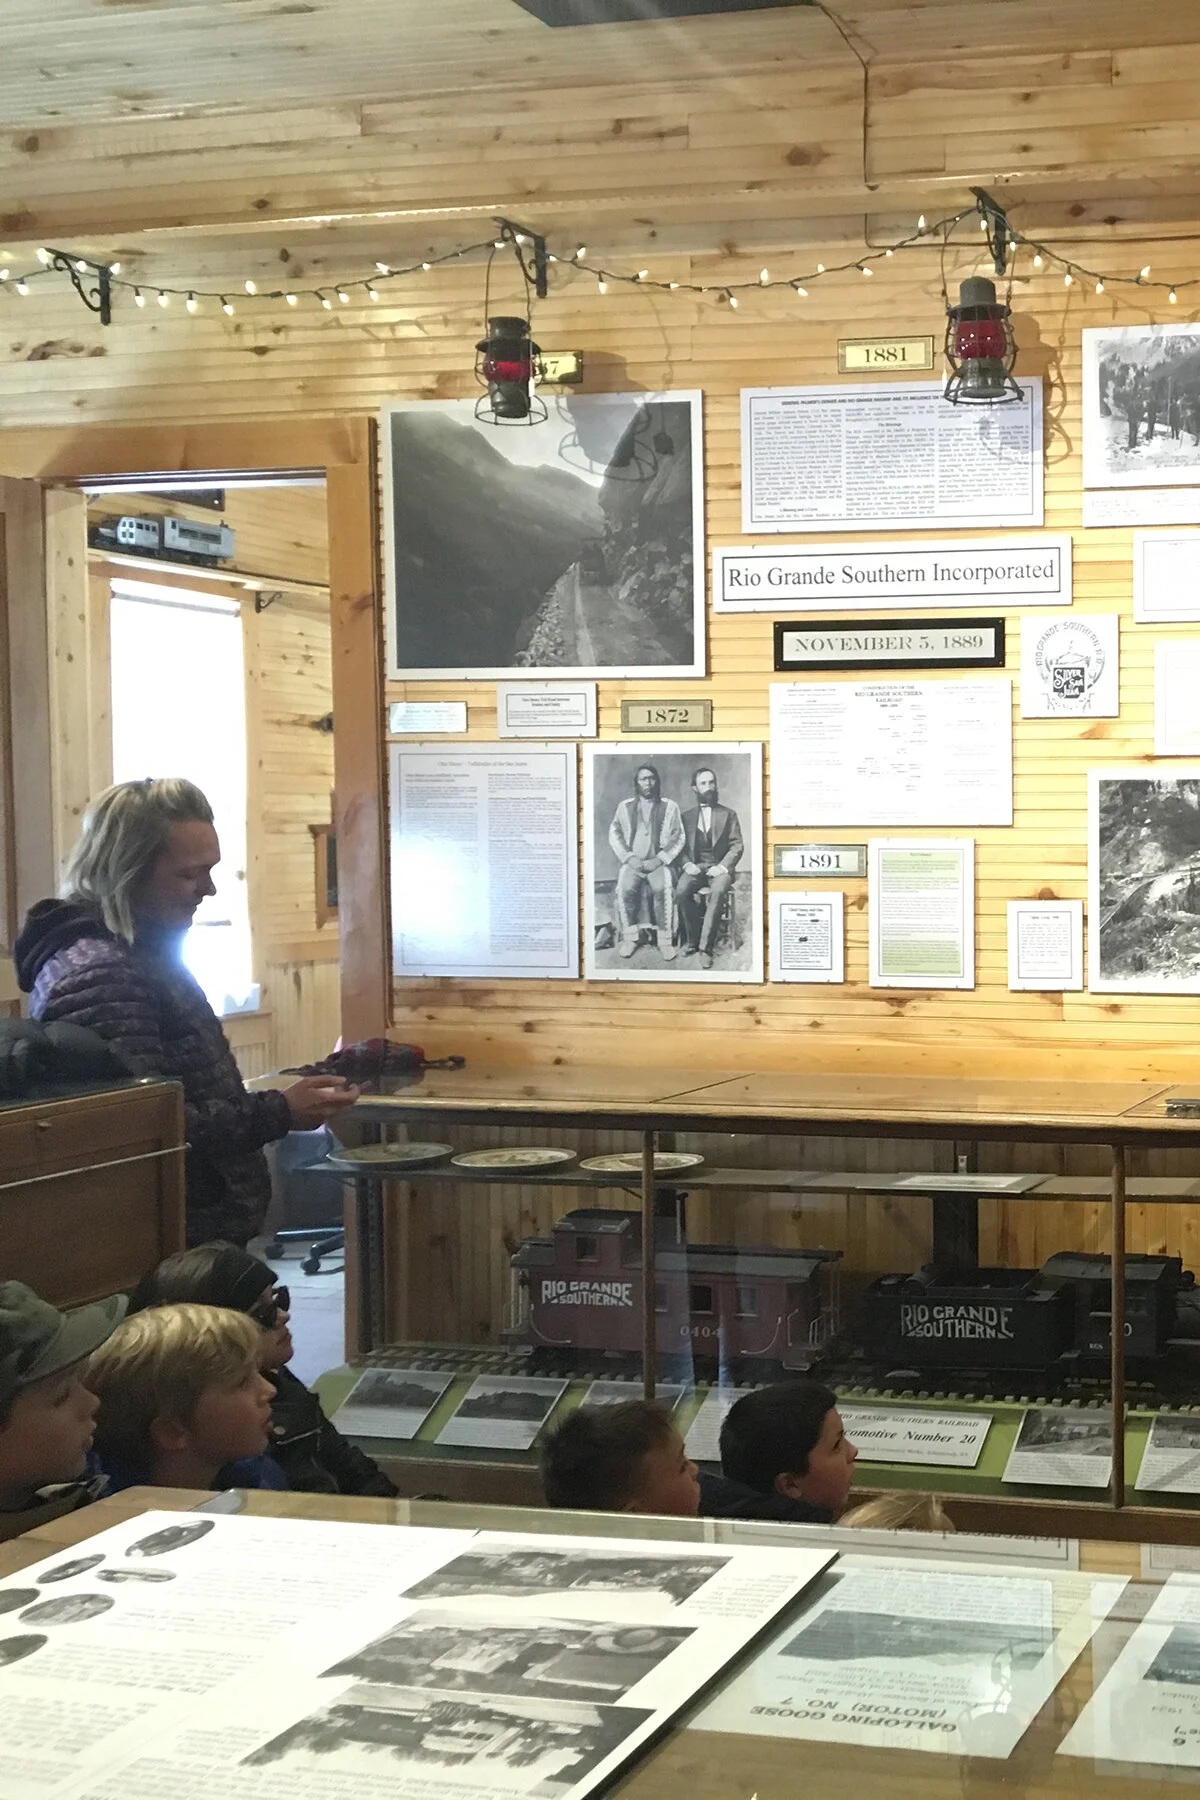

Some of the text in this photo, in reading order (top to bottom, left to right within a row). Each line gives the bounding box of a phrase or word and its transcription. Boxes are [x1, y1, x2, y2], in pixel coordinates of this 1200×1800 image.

[863, 346, 908, 364] 1881
[729, 558, 1055, 587] Rio Grande Southern Incorporated
[795, 634, 984, 654] NOVEMBER 5, 1889
[646, 708, 690, 724] 1872
[800, 854, 842, 869] 1891
[541, 1280, 633, 1307] RIO GRANDE
[559, 1291, 619, 1307] SOUTHERN
[900, 1303, 1014, 1338] RIO GRANDE
[914, 1319, 996, 1339] SOUTHERN
[937, 1419, 979, 1428] RAILROAD
[843, 1428, 978, 1444] comotive Number 20
[779, 1697, 948, 1719] (MOTOR) NO. 7
[749, 1705, 957, 1734] GALLOPING GOOSE
[1171, 1738, 1187, 1747] 6
